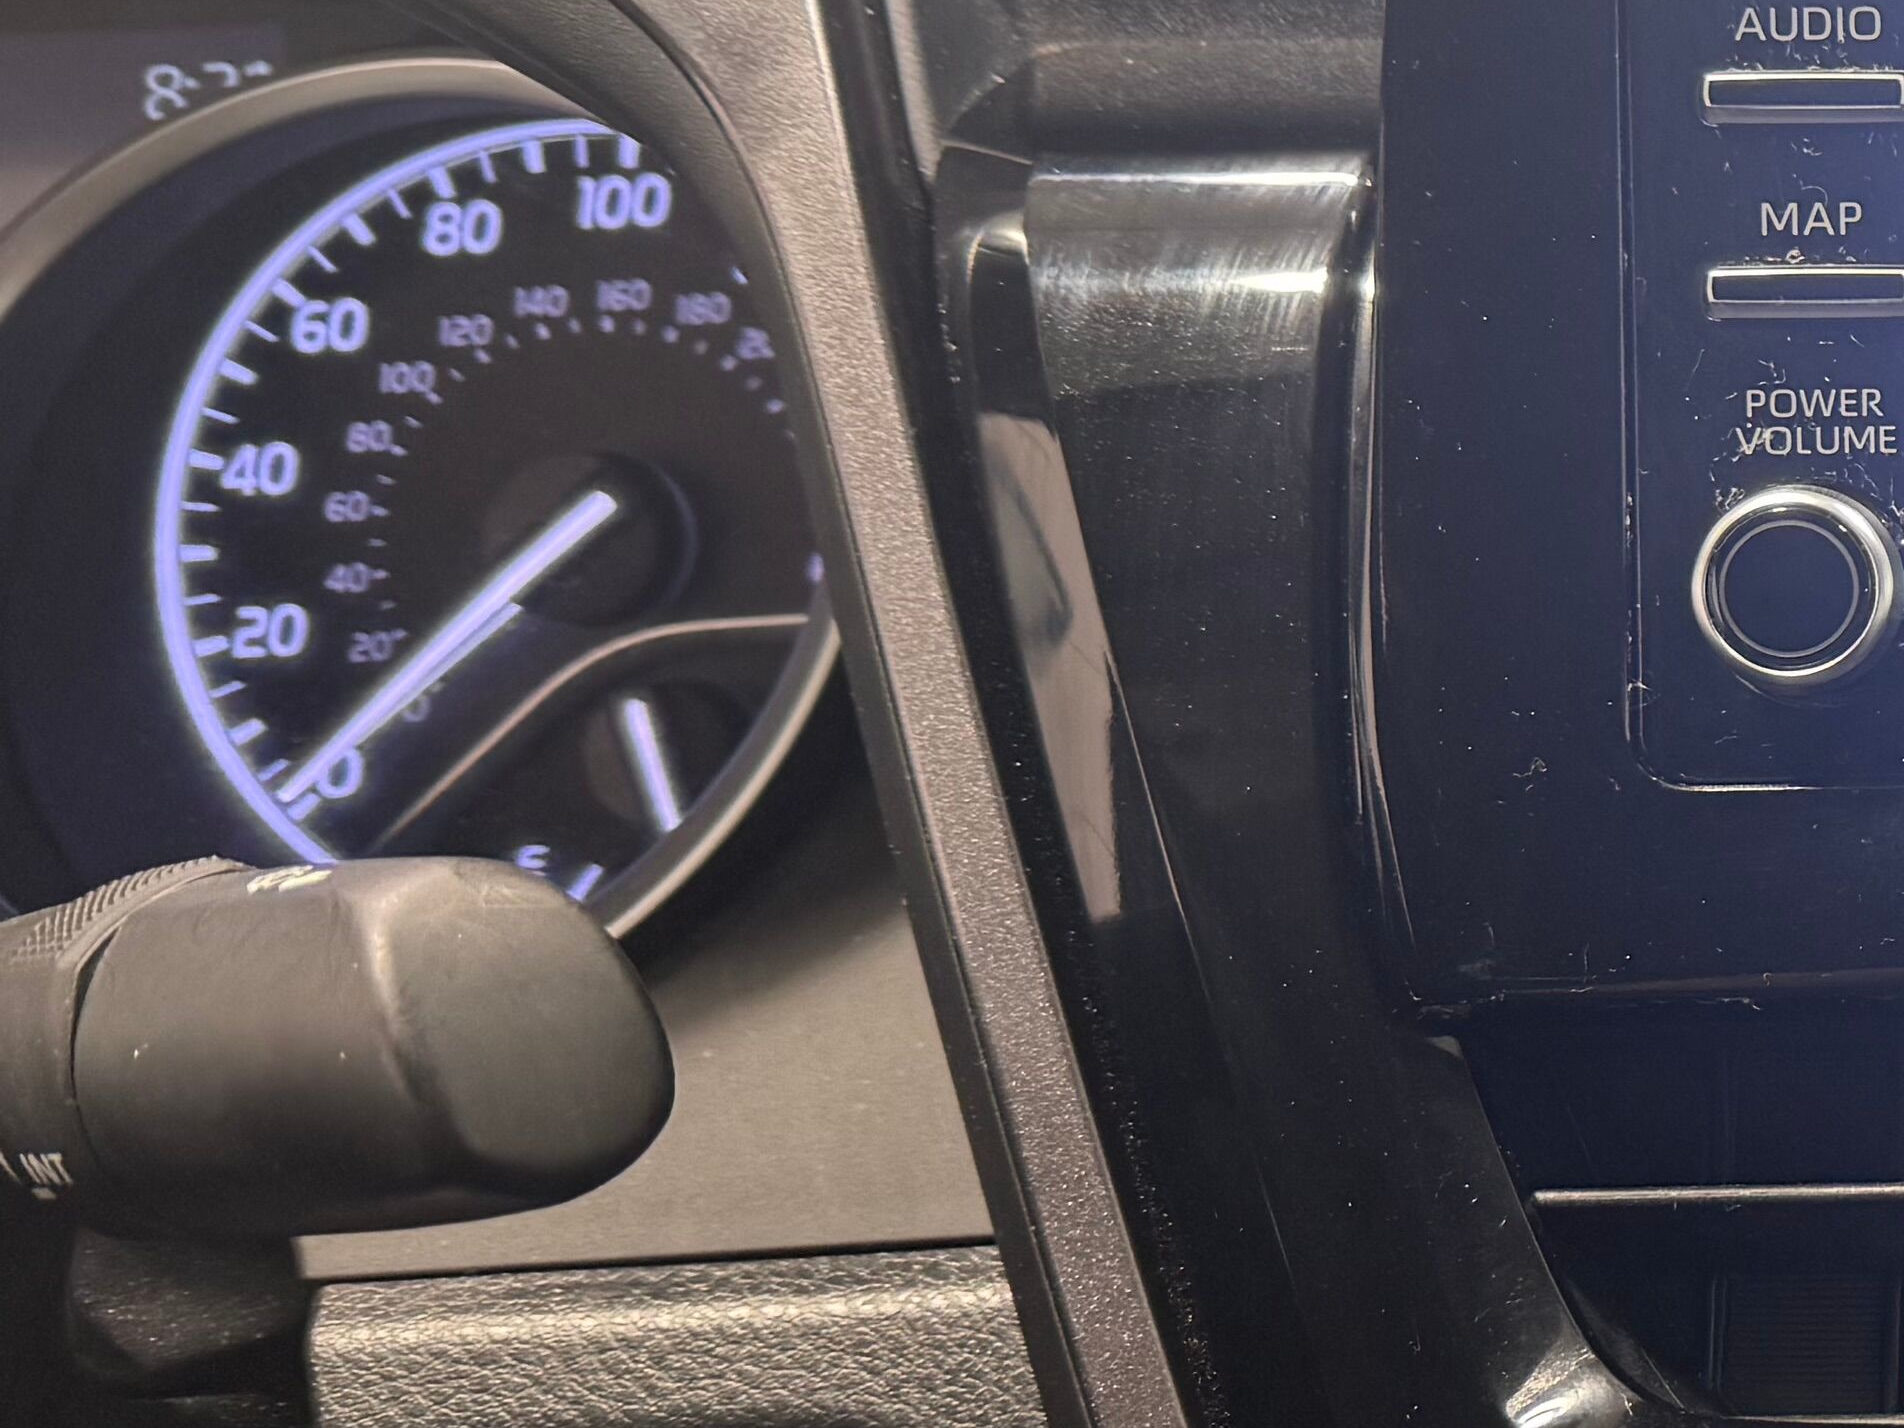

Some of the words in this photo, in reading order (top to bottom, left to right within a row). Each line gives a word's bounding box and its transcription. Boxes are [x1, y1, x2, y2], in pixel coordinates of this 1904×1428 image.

[1734, 5, 1882, 42] AUDIO
[576, 175, 672, 230] 100
[1760, 201, 1863, 236] MAP
[422, 200, 502, 255] 80
[290, 298, 368, 353] 60
[439, 314, 495, 347] 120
[379, 361, 437, 394] 100
[1745, 387, 1883, 419] POWER
[1735, 424, 1898, 456] VOLUME
[222, 442, 298, 495] 40
[233, 606, 306, 660] 20
